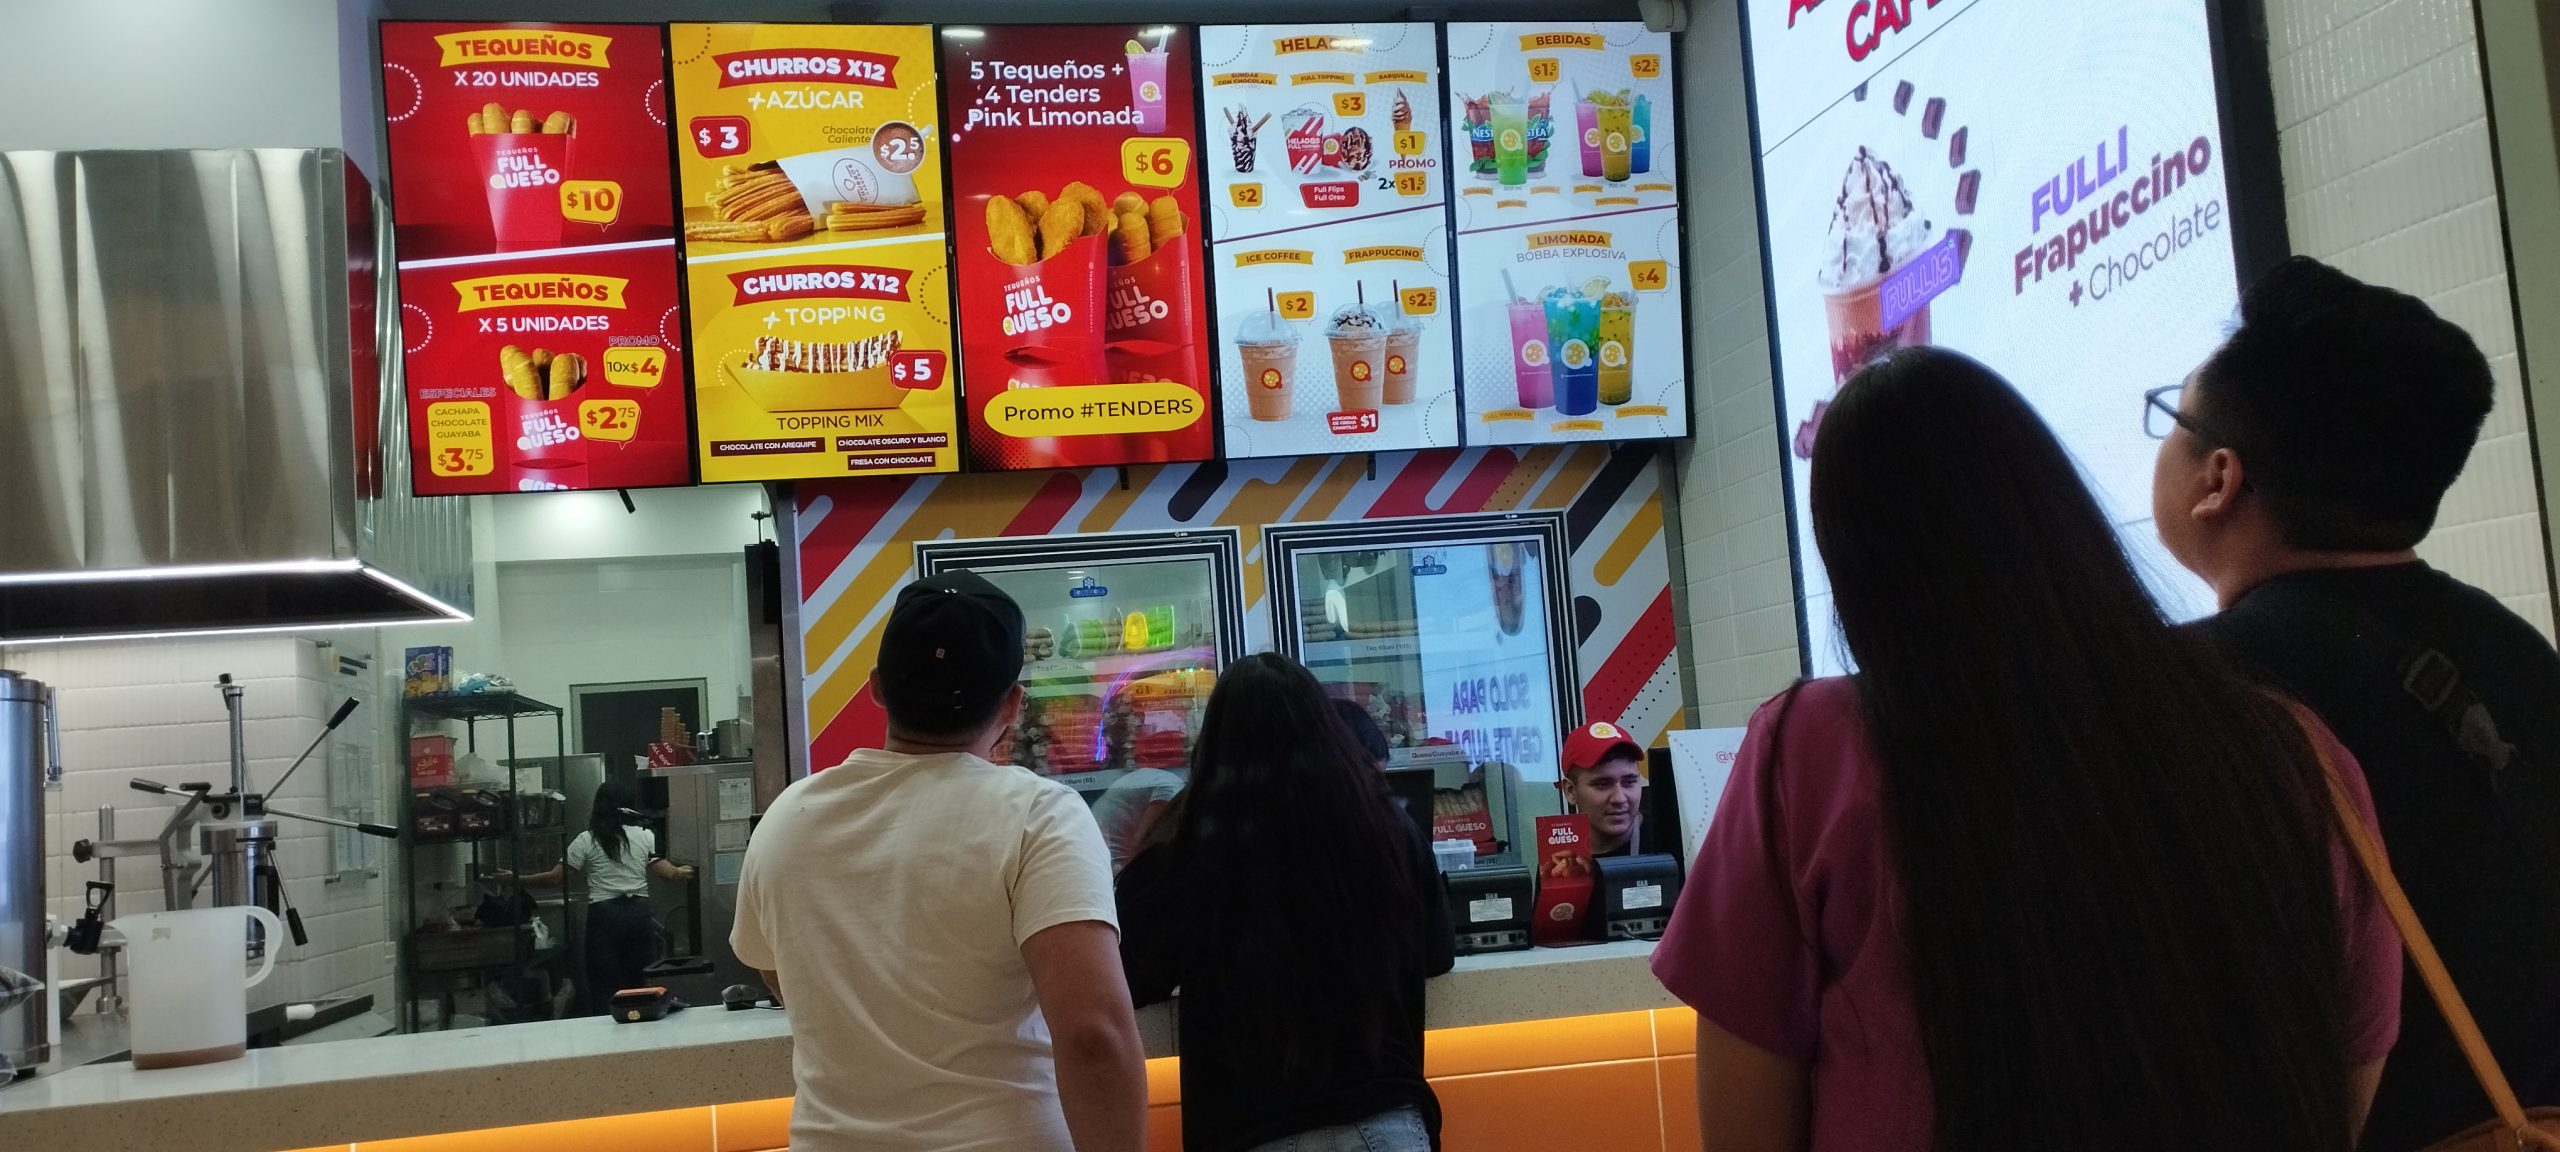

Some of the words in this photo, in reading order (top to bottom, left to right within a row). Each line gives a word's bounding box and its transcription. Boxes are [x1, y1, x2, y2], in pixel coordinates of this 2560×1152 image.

[1846, 0, 1942, 61] CA
[455, 34, 592, 60] TEQUEÑOS
[1281, 37, 1354, 52] HELA
[1536, 35, 1591, 46] BEBIDAS
[727, 57, 841, 79] CHURROS
[846, 58, 886, 82] X12
[970, 61, 984, 80] 5
[990, 60, 1105, 84] Tequeños
[455, 71, 468, 86] X
[472, 71, 496, 86] 20
[501, 71, 599, 87] UNIDADES
[984, 86, 1000, 104] 4
[1005, 85, 1101, 104] Tenders
[1341, 97, 1361, 111] $3
[968, 107, 1022, 127] Pink
[1028, 106, 1145, 126] Limonada
[822, 126, 876, 135] Chocolate
[827, 134, 871, 144] Caliente
[1400, 135, 1416, 149] $1
[497, 155, 547, 172] FULL
[1135, 148, 1173, 176] $6
[1389, 158, 1436, 169] PROMO
[489, 168, 560, 189] QUESO
[2032, 124, 2128, 234] FULLI
[567, 188, 615, 211] $10
[1238, 189, 1257, 203] $2
[2014, 135, 2212, 296] Frapuccino
[1536, 234, 1606, 246] LIMONADA
[1246, 255, 1261, 263] ICE
[1264, 252, 1301, 261] COFFEE
[1349, 248, 1420, 260] FRAPPUCCINO
[1516, 250, 1559, 263] BOBBA
[1563, 248, 1626, 261] EXPLOSIVA
[2090, 200, 2220, 301] Chocolate
[743, 271, 856, 295] CHURROS
[860, 272, 900, 294] X12
[1003, 275, 1041, 292] TEQUEÑOS
[1637, 268, 1660, 284] $4
[473, 278, 608, 302] TEQUEÑOS
[1005, 285, 1053, 314] FULL
[1286, 298, 1307, 312] $2
[479, 318, 492, 332] X
[497, 317, 508, 332] 5
[512, 316, 609, 332] UNIDADES
[785, 306, 886, 326] TOPPING
[1002, 302, 1072, 336] QUESO
[609, 335, 660, 346] PROMO
[420, 387, 497, 400] ESPECIALES
[435, 408, 480, 416] CACHAPA
[1004, 404, 1074, 421] Promo
[1080, 398, 1194, 418] #TENDERS
[431, 418, 487, 427] CHOCOLATE
[522, 415, 567, 434] FULL
[776, 415, 851, 431] TOPPING
[855, 414, 884, 428] MIX
[1361, 413, 1376, 428] $1
[437, 430, 481, 438] GUAYABA
[517, 426, 580, 451] QUESO
[838, 437, 881, 447] CHOCOLATE
[882, 436, 911, 445] OSCURO
[911, 436, 918, 444] Y
[918, 435, 946, 444] BLANCO
[719, 443, 763, 451] CHOCOLATE
[764, 442, 781, 450] CON
[782, 440, 816, 449] AREQUIPE
[850, 457, 873, 466] FRESA
[874, 456, 890, 465] CON
[890, 455, 933, 465] CHOCOLATE
[1433, 825, 1454, 835] FULL
[1455, 822, 1486, 832] QUESO
[1552, 827, 1573, 836] FULL
[1548, 835, 1579, 845] QUESO
